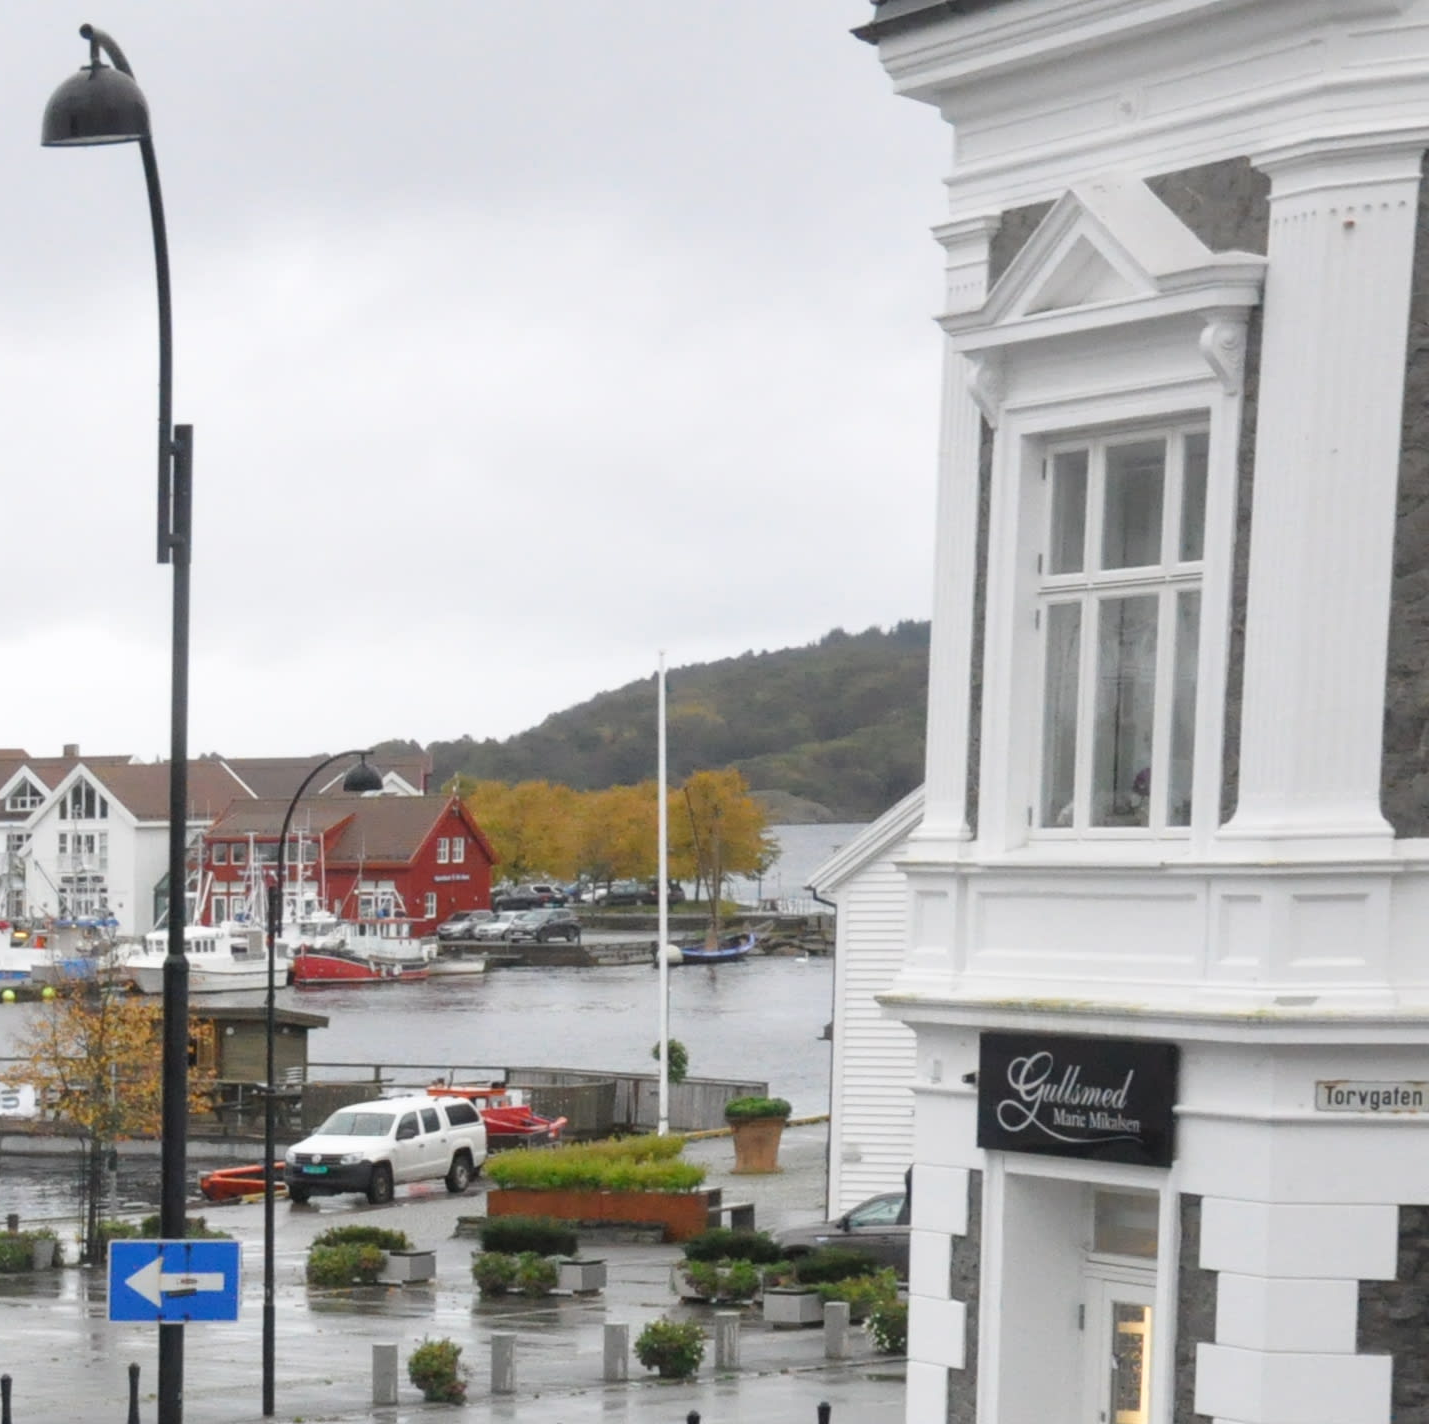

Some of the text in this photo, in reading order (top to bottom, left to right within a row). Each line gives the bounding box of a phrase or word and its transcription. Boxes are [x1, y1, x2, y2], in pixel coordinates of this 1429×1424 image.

[998, 1051, 1135, 1131] Gullsmed
[1325, 1085, 1423, 1111] Torvgaten
[1053, 1108, 1140, 1133] Marie Mikalsen
